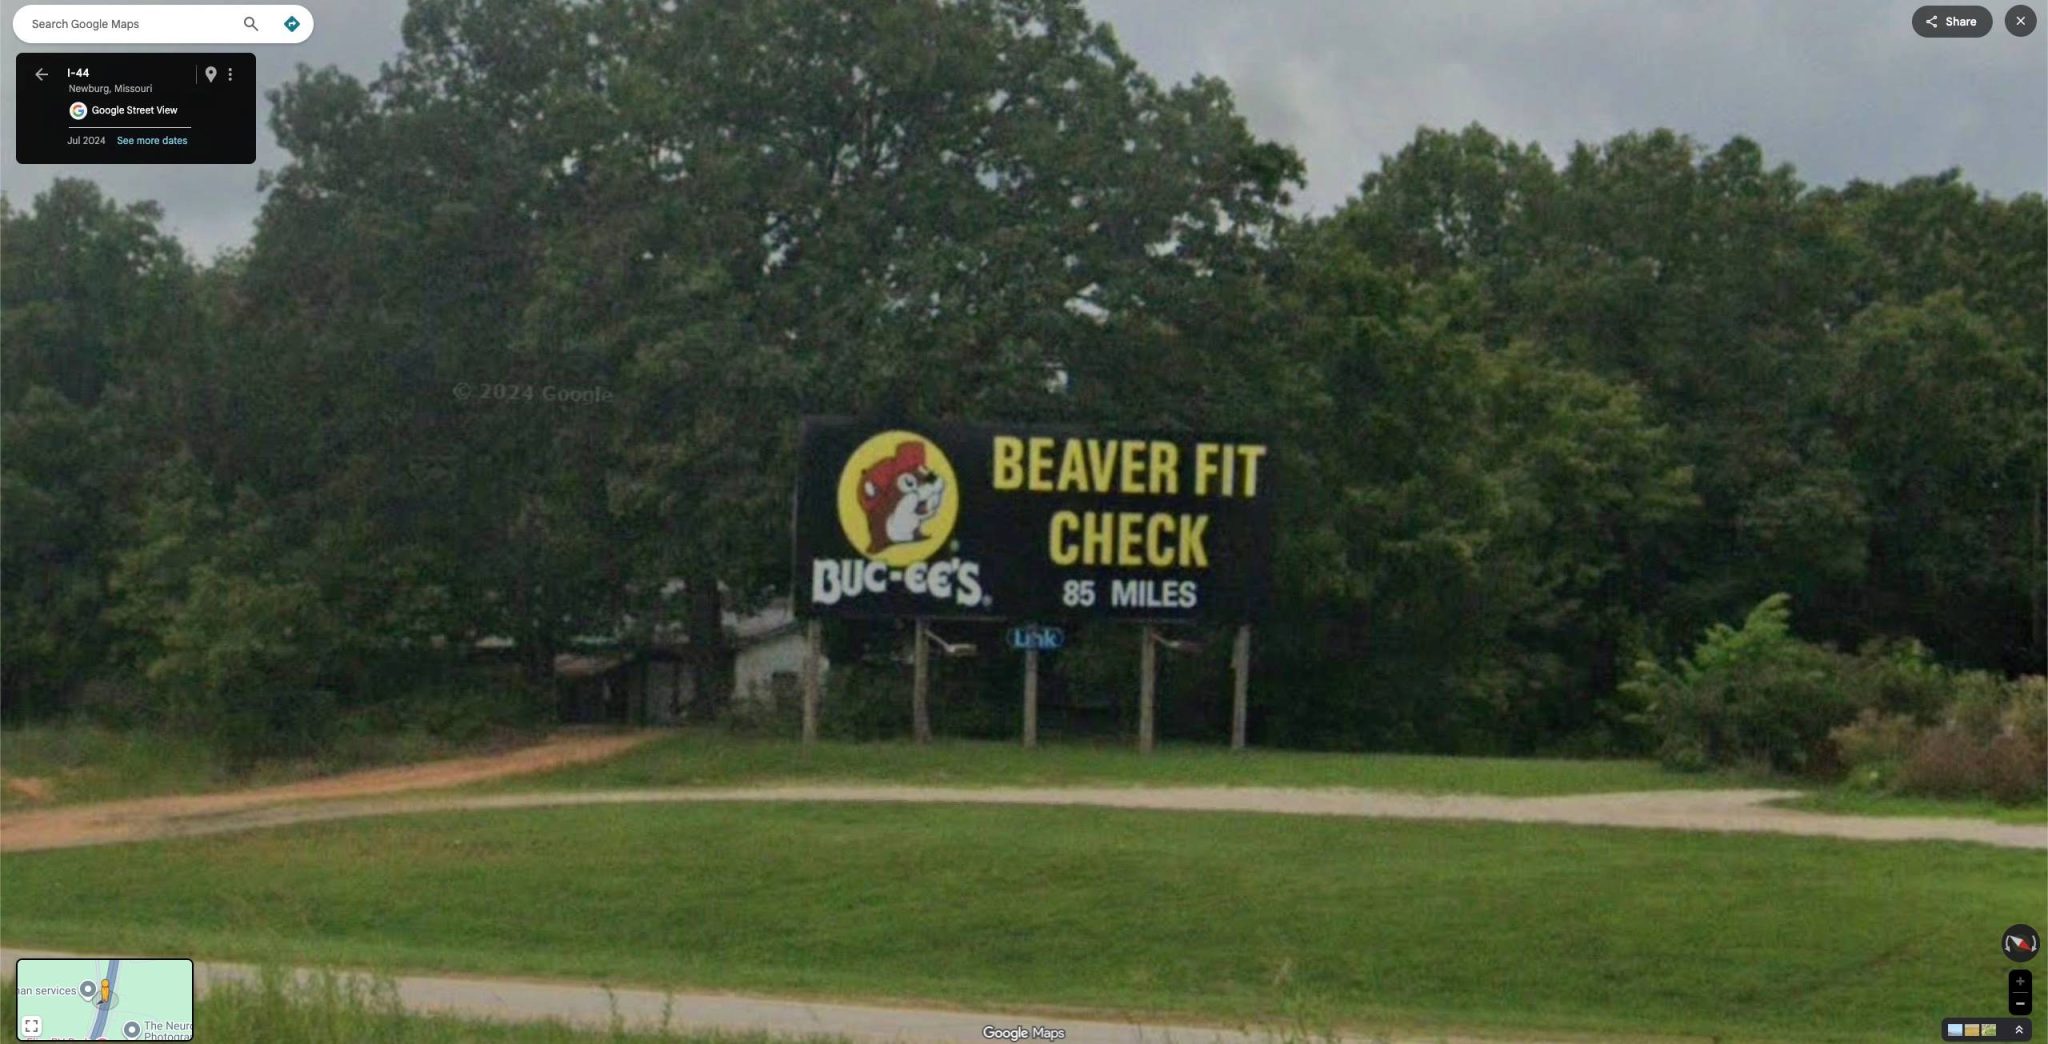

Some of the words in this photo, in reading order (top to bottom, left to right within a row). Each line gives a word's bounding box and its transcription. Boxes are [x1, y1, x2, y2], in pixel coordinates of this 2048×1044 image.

[993, 435, 1178, 495] BEAVER
[1194, 441, 1267, 499] FIT
[1048, 510, 1210, 569] CHECK
[1062, 580, 1096, 607] 85
[1111, 580, 1198, 608] MILES
